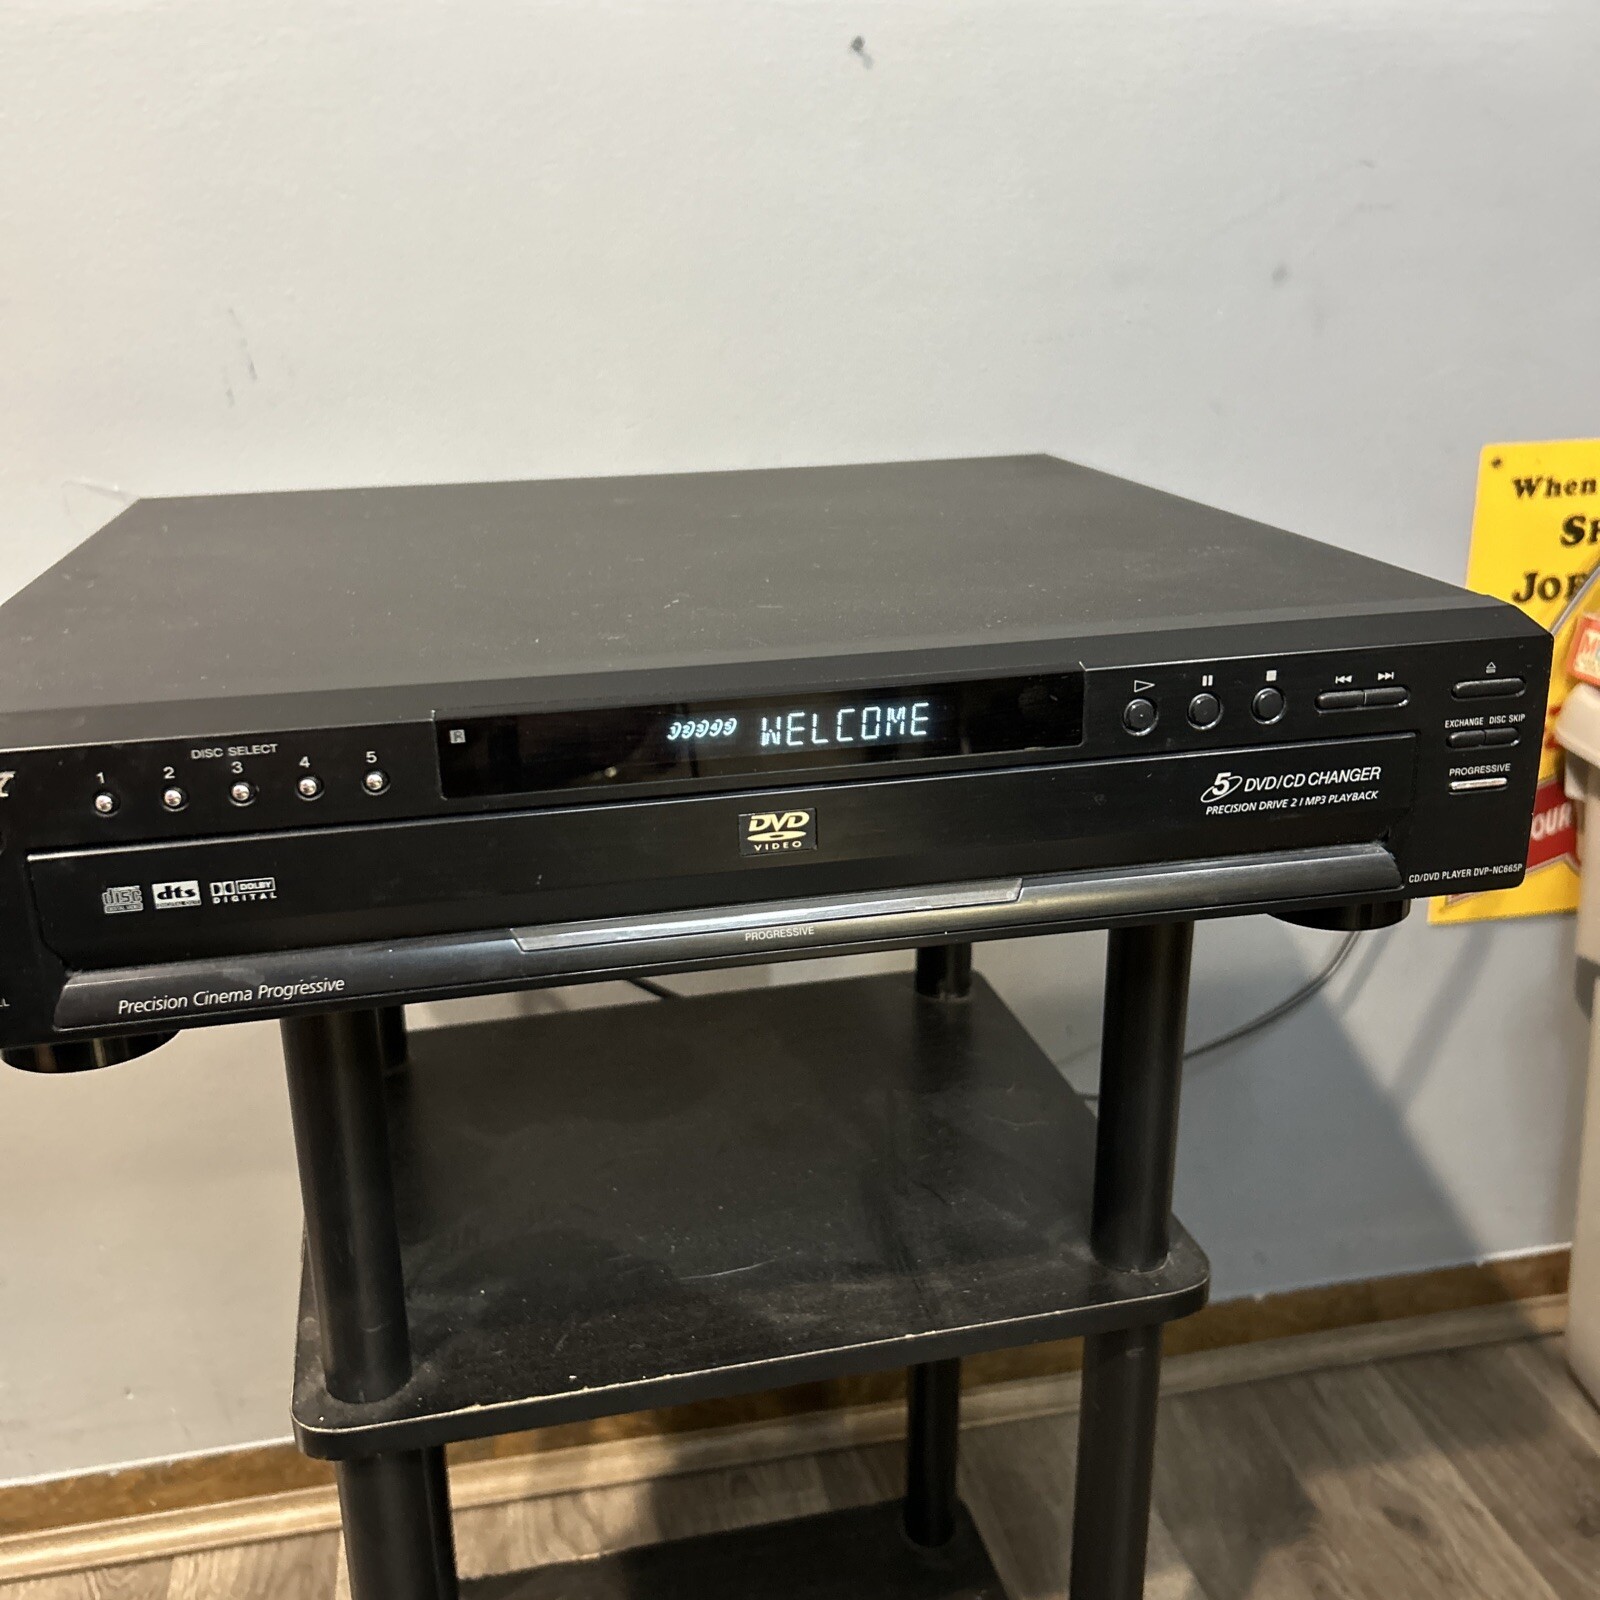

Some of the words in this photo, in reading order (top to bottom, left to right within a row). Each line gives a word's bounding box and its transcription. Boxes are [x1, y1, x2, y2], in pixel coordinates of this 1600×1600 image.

[1512, 476, 1597, 498] When
[761, 703, 930, 747] WELCOME
[1444, 717, 1484, 728] EXCHANGE
[1489, 715, 1507, 724] DISC
[1508, 713, 1526, 723] SKIP
[191, 748, 223, 759] DISC
[228, 743, 279, 756] SELECT
[366, 751, 378, 763] 5
[231, 761, 243, 774] 3
[299, 756, 310, 769] 4
[163, 766, 175, 779] 2
[1449, 763, 1511, 776] PROGRESSIVE
[97, 772, 105, 784] 1
[1244, 773, 1306, 792] DVD/CD
[1307, 766, 1382, 786] CHANGER
[1205, 802, 1257, 815] PRECISION
[1258, 799, 1289, 811] DRIVE
[1290, 799, 1298, 808] 2
[1304, 795, 1327, 806] MP3
[1328, 790, 1379, 804] PLAYBACK
[748, 811, 810, 832] DVD
[754, 840, 802, 851] VIDEO
[1408, 872, 1440, 884] CD/DVD
[1441, 868, 1472, 880] PLAYER
[1473, 863, 1523, 877] DVP-NC665P
[239, 881, 272, 891] DOLBY
[157, 886, 196, 900] dts
[213, 892, 278, 904] DIGITAL
[745, 926, 815, 941] PROGRESSIVE
[118, 995, 188, 1015] Precision
[193, 988, 253, 1007] Cinema
[257, 977, 346, 1001] Progressive
